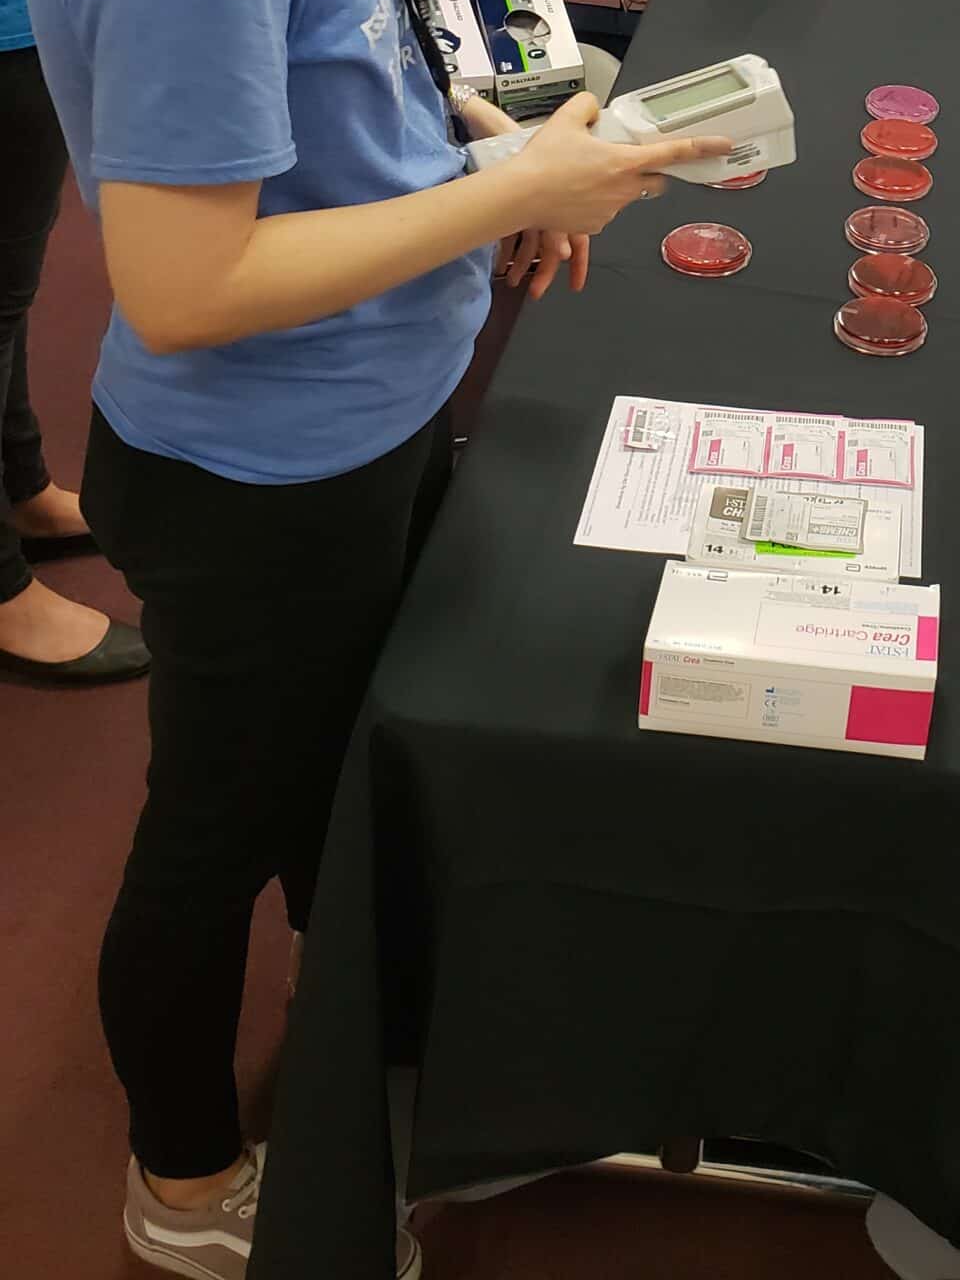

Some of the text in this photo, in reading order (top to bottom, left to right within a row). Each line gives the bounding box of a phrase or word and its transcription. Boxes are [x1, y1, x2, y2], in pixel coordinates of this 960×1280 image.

[510, 76, 541, 85] HALYARD
[705, 544, 724, 554] 14
[821, 584, 842, 595] 14
[795, 624, 869, 641] Cartridge
[872, 631, 911, 646] Crea
[682, 655, 701, 665] Crea
